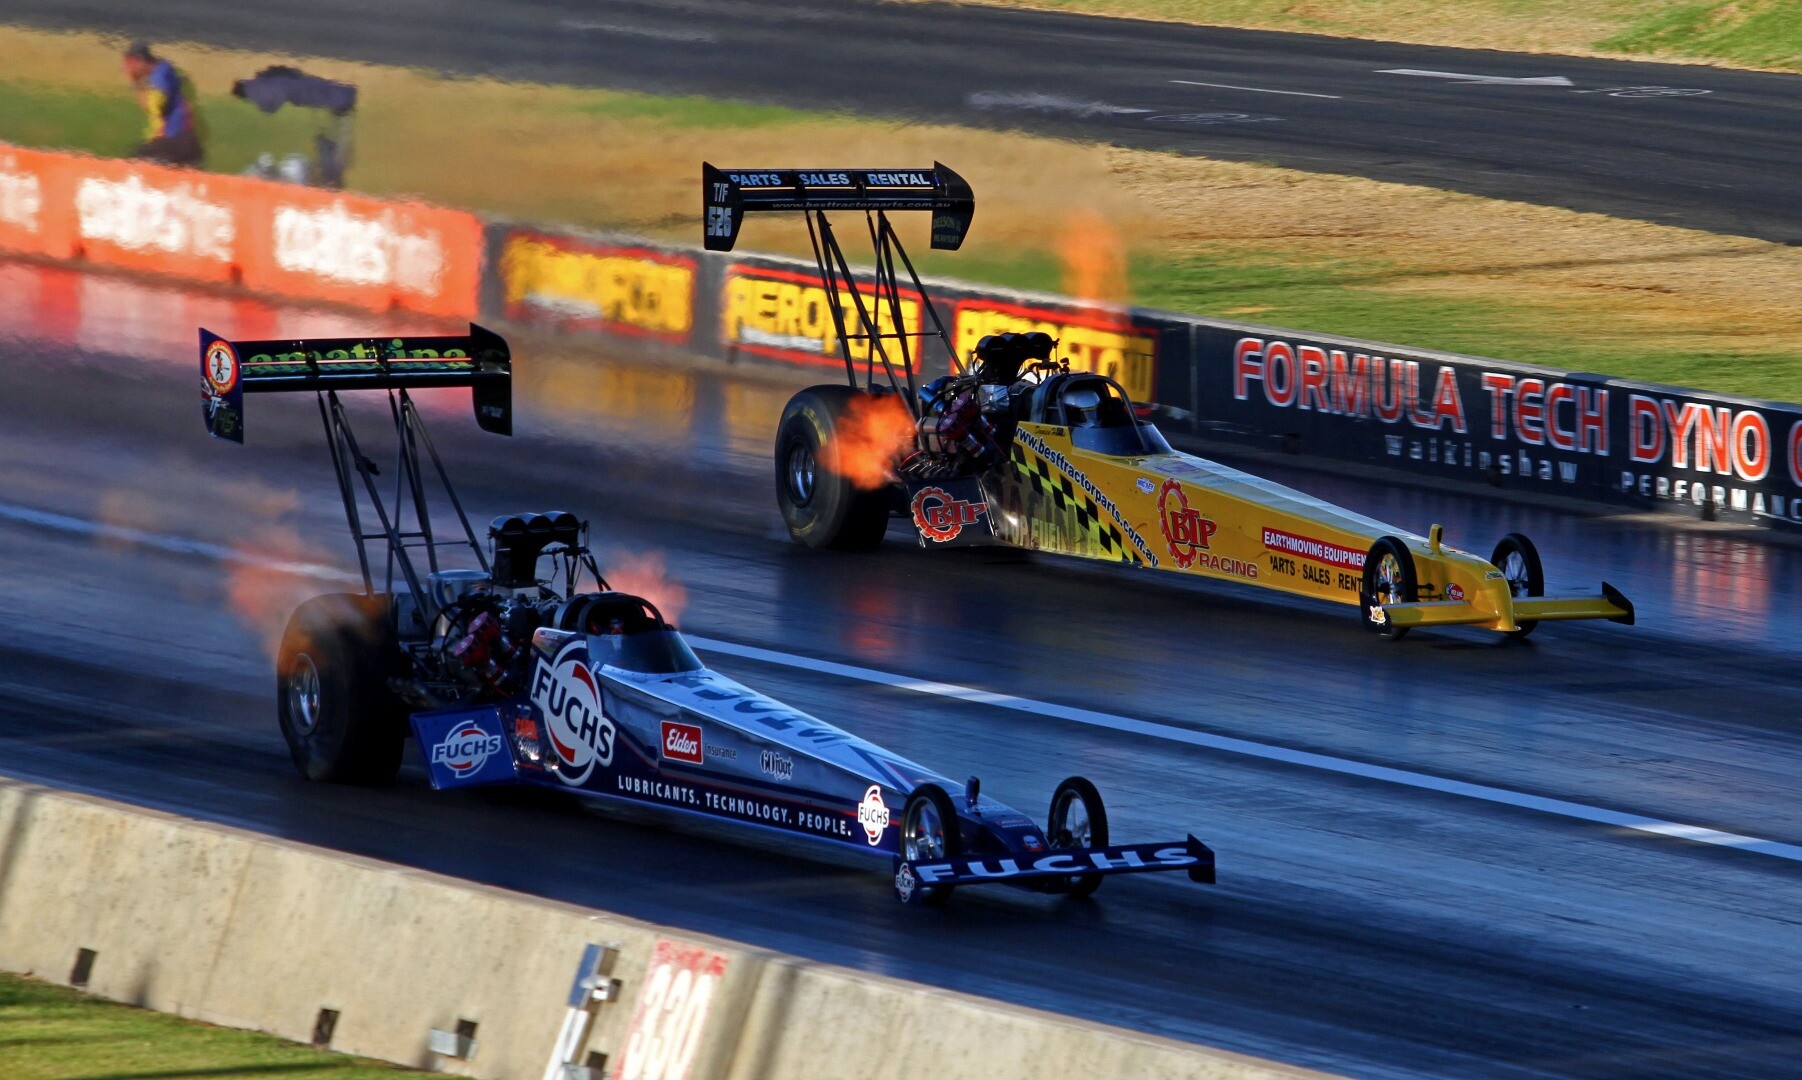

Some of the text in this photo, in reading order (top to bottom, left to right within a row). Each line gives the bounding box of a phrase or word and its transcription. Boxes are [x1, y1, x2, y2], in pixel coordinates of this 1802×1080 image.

[713, 183, 729, 203] T/F
[730, 173, 930, 186] PARTS SALES RENTAL
[772, 200, 951, 209] www.besttractorparts.com.au
[707, 206, 732, 237] 526
[1233, 336, 1468, 435] FORMULA
[1481, 371, 1610, 457] TECH
[1629, 393, 1772, 482] DYNO
[928, 499, 988, 527] BTP
[1170, 507, 1218, 549] BTP
[1264, 531, 1323, 558] EARTHMOVING
[1199, 552, 1259, 580] RACING
[1303, 565, 1331, 586] SALES
[534, 668, 612, 760] FUCHS
[434, 738, 500, 762] FUCHS
[666, 728, 737, 760] Elders Insurance
[618, 774, 852, 837] LUBRICANTS. TECHNOLOGY. PEOPLE.
[860, 806, 888, 825] FUCHS
[915, 848, 1198, 882] FUCHS
